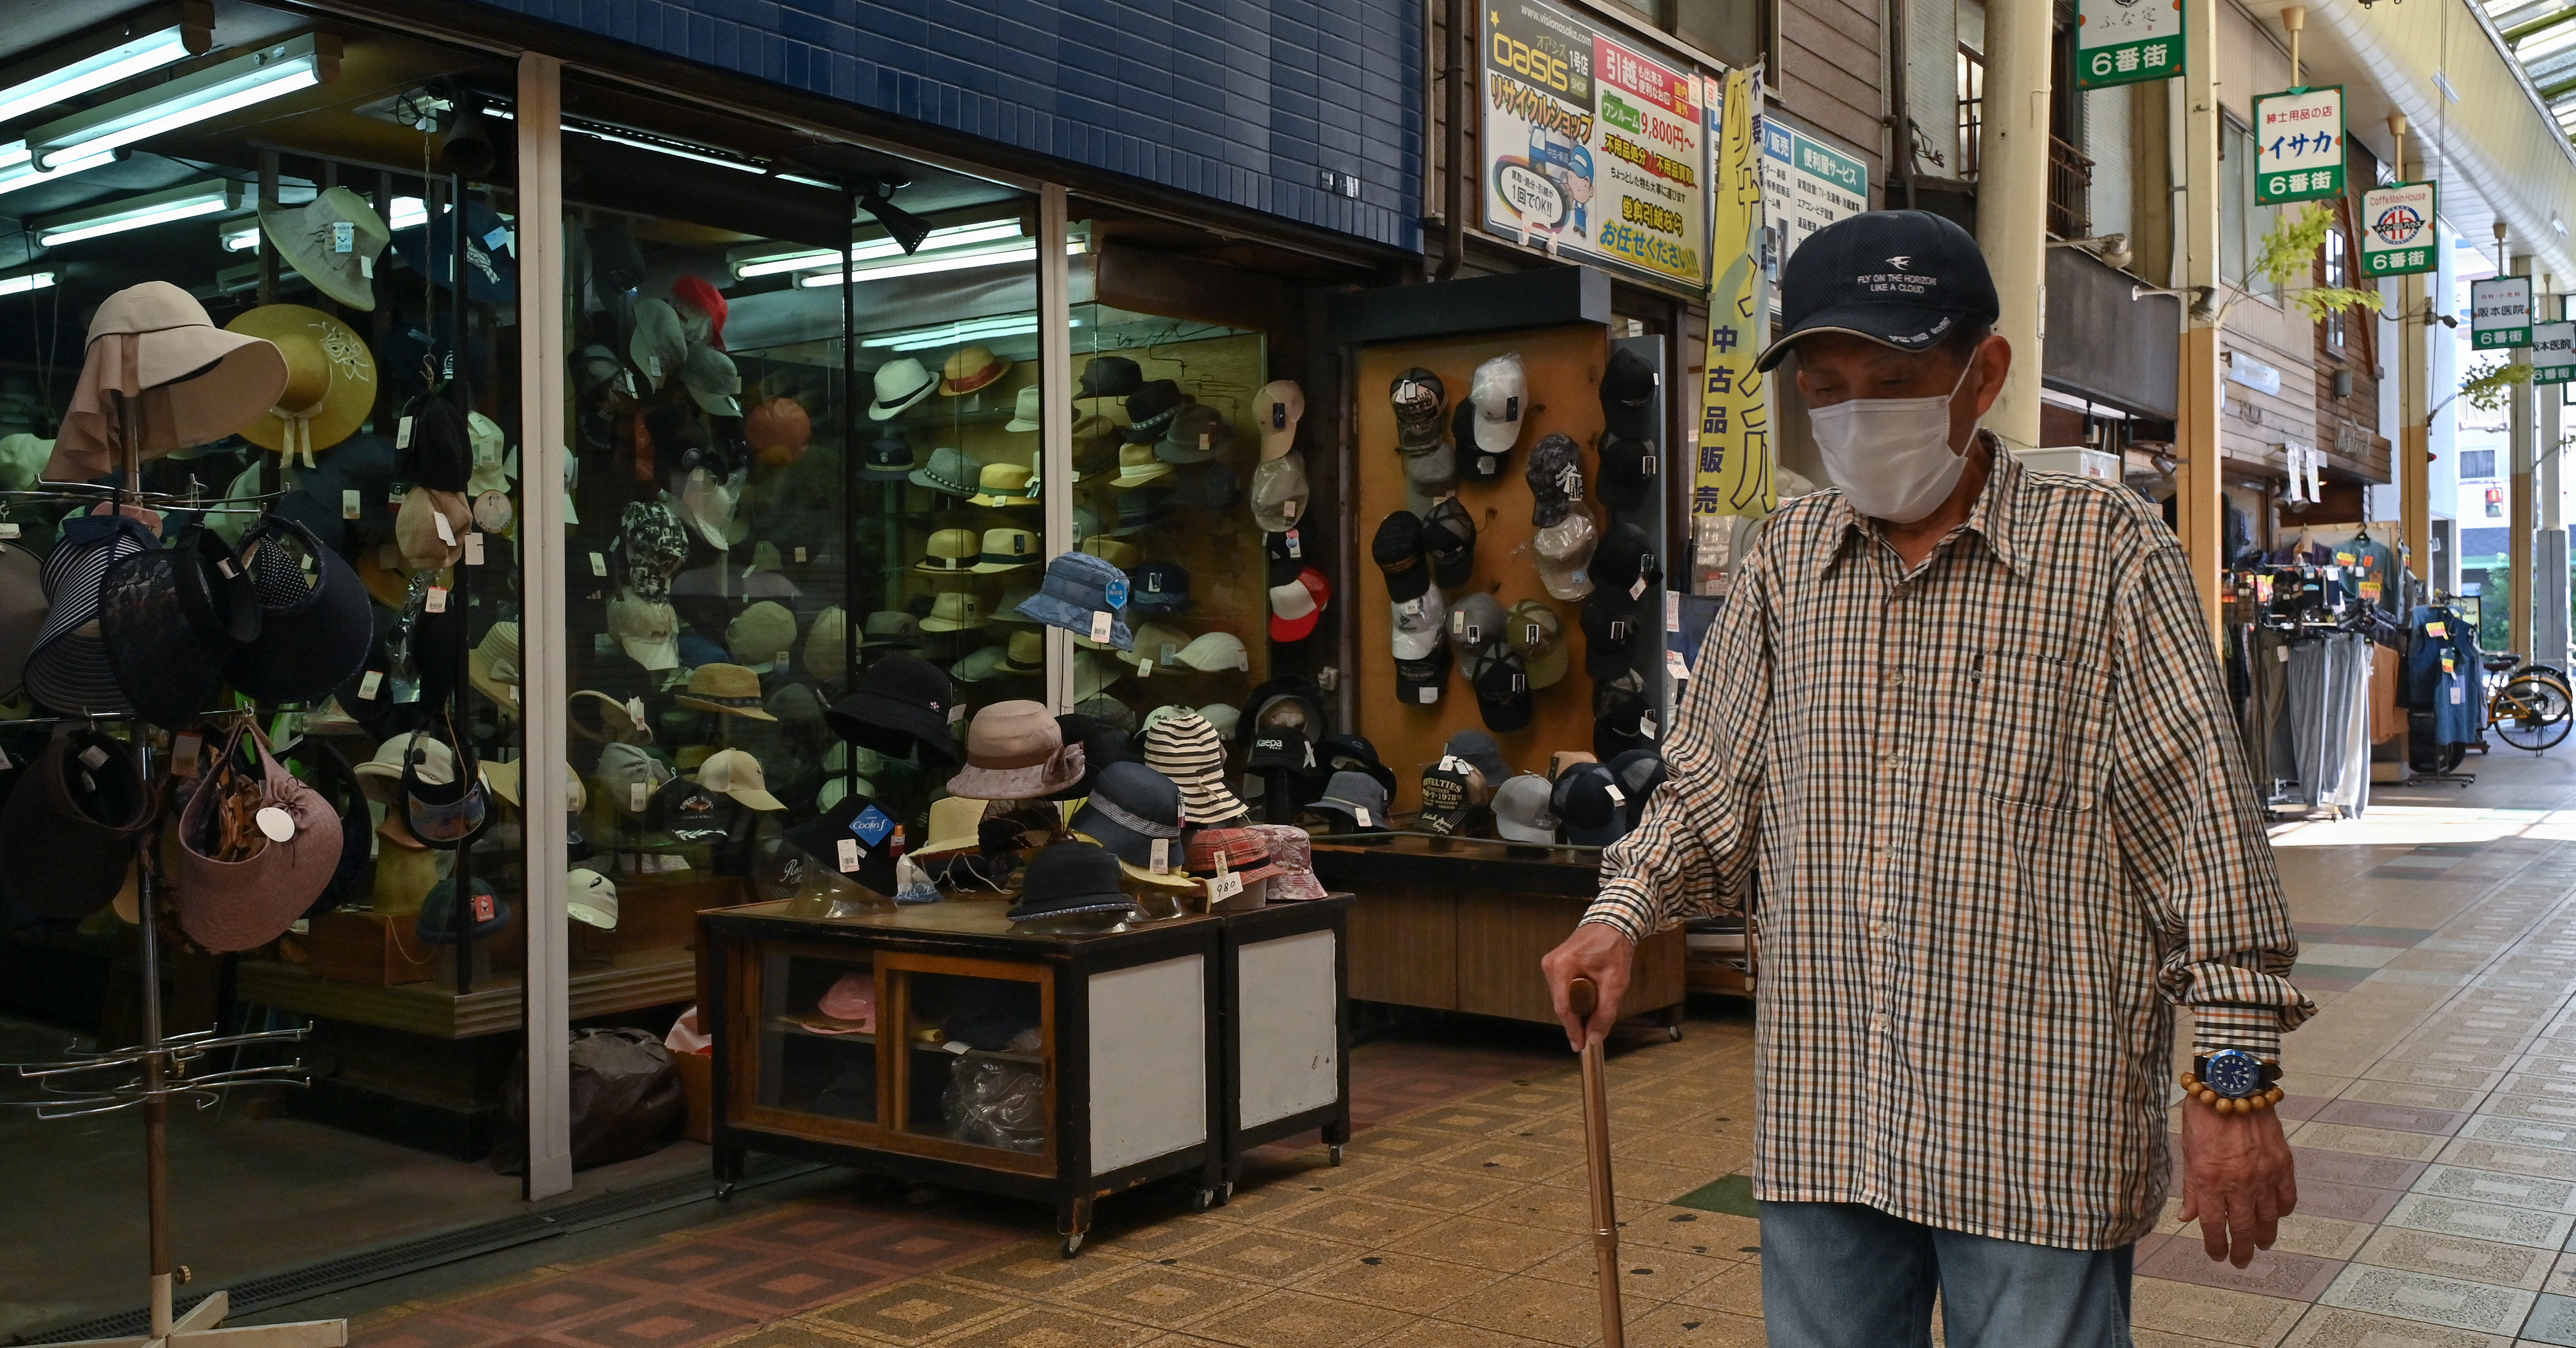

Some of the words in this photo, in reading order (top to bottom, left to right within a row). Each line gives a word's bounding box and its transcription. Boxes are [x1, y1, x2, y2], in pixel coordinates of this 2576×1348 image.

[1521, 5, 1592, 47] www.visionosaka.com
[1536, 35, 1568, 61] オアシス
[2092, 44, 2167, 75] 6番街
[1569, 50, 1588, 76] 1号店
[1606, 48, 1638, 90] 引越
[1571, 78, 1587, 93] SHOP
[1638, 65, 1663, 87] も出来る
[1639, 80, 1671, 105] 便利なお店
[1491, 73, 1594, 145] リサイクルショップ
[1604, 103, 1639, 129] ワンルーム
[2266, 106, 2332, 124] 紳士用品の店
[1764, 129, 1789, 157] /販売
[2268, 130, 2332, 160] イサカ
[1804, 147, 1857, 185] 便利屋サービス
[2270, 171, 2331, 195] 6番街
[1622, 195, 1683, 238] 単身引越なら
[2373, 251, 2425, 270] 6番街
[1857, 275, 1871, 284] FLY
[1873, 274, 1885, 282] ON
[1888, 274, 1903, 282] THE
[1904, 276, 1937, 286] HORIZON
[1871, 284, 1888, 292] LIKE
[1898, 284, 1925, 294] CLOUD
[2478, 304, 2524, 318] 阪本医院
[2481, 330, 2523, 345] 6番街
[1693, 325, 1738, 513] 中古品販売
[1256, 738, 1283, 749] Kaepa
[680, 795, 697, 810] SPEED
